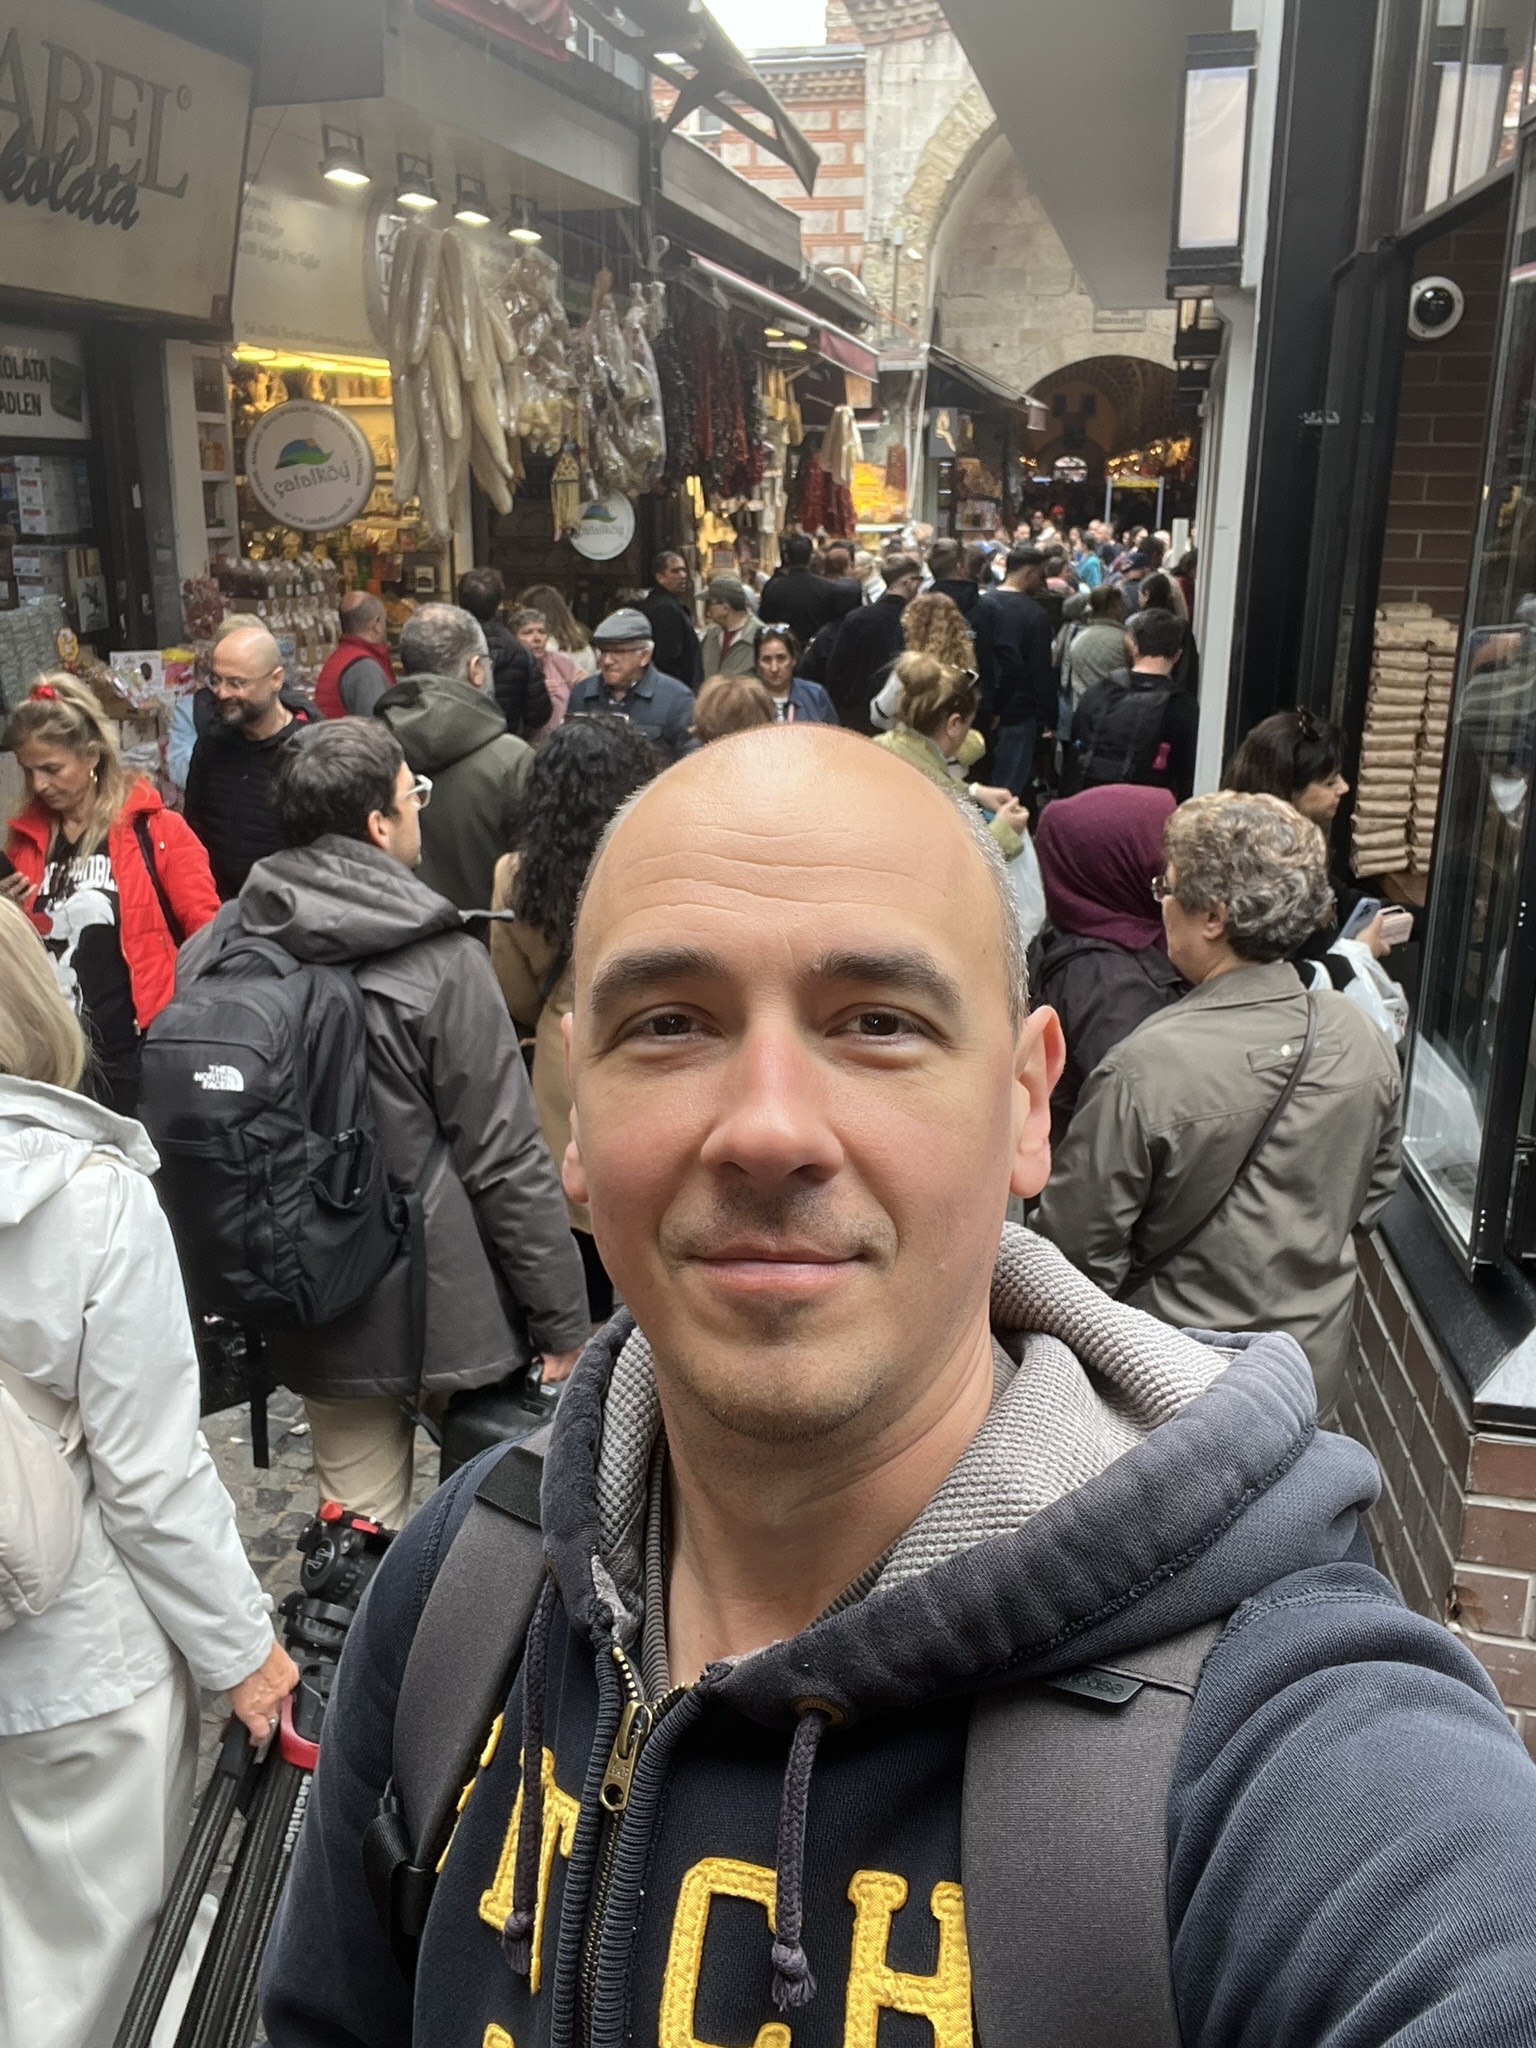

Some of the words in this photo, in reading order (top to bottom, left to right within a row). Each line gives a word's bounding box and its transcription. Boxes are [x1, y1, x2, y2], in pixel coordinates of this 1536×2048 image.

[0, 353, 51, 383] OLATA
[193, 1072, 226, 1081] NORTH
[202, 1080, 226, 1090] FACE
